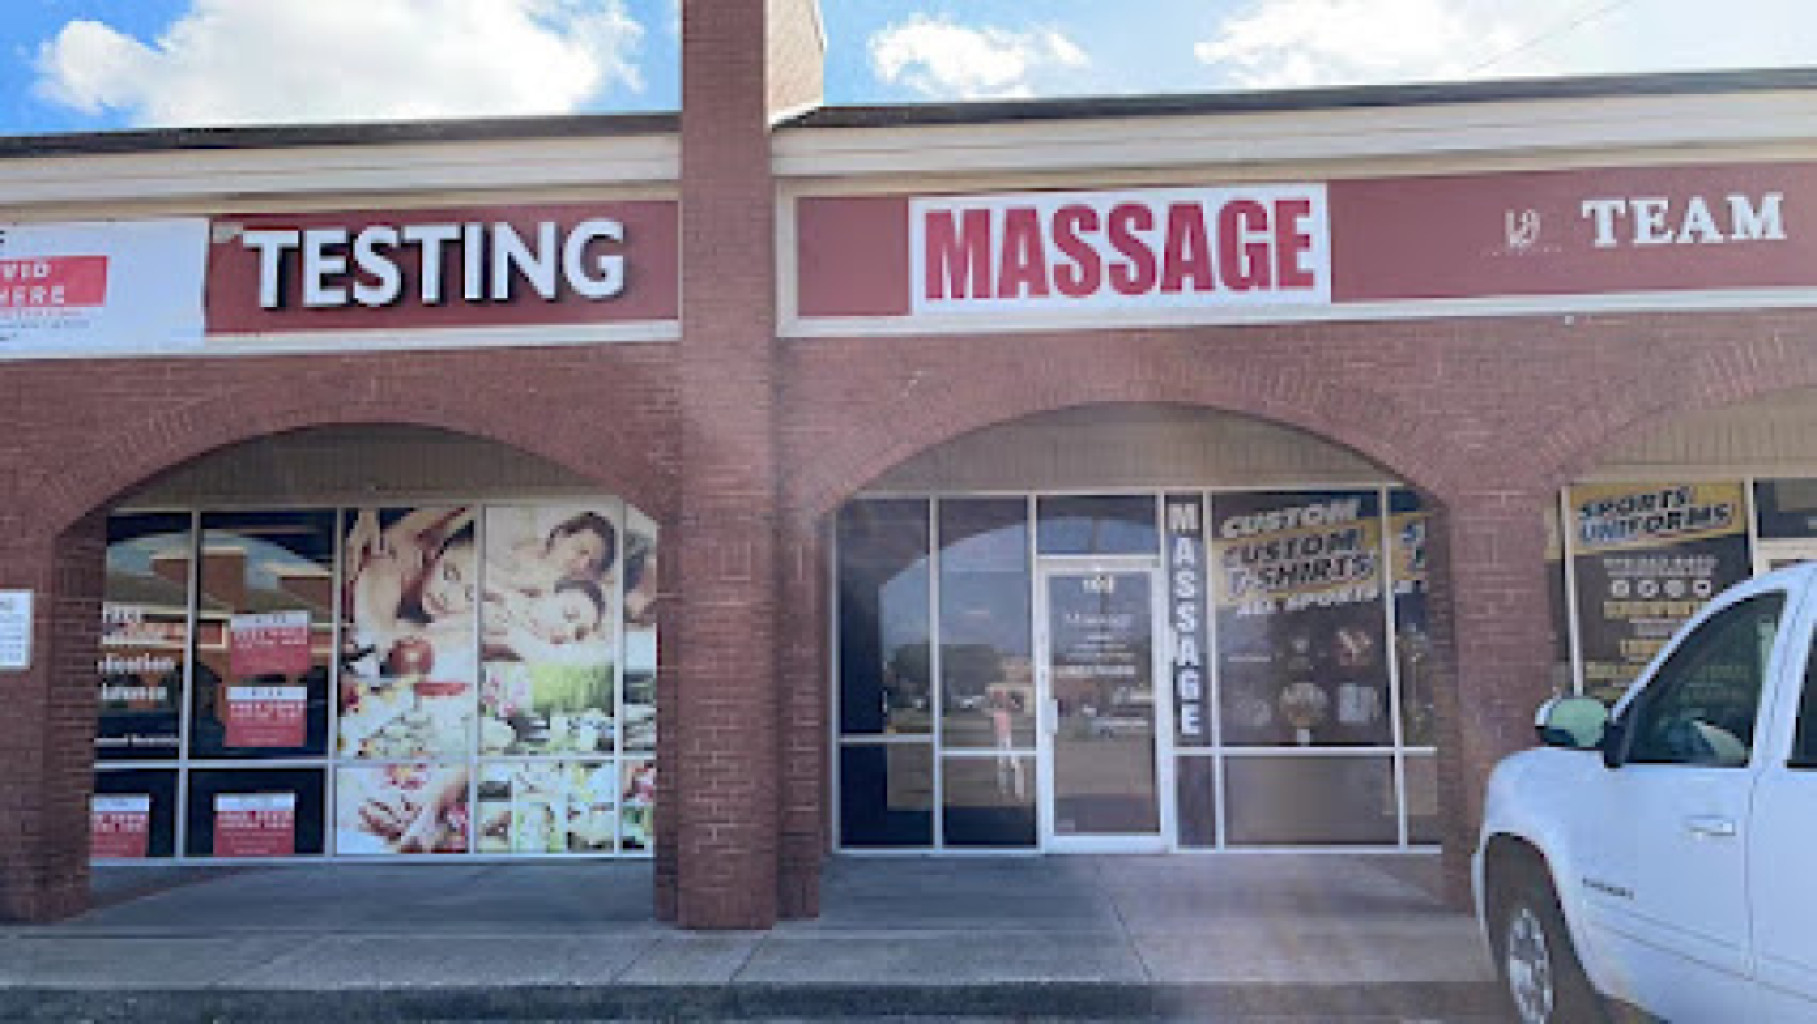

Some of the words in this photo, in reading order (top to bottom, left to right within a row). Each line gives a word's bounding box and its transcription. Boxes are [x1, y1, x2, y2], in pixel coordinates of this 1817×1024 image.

[1581, 192, 1788, 248] TEAM
[241, 218, 626, 308] TESTING
[924, 197, 1317, 302] MASSAGE
[1221, 497, 1361, 538] CUSTOM
[1578, 486, 1694, 519] SPORTS
[1579, 502, 1733, 545] UNIFORMS
[1221, 530, 1363, 569] CUSTOM
[1168, 503, 1203, 736] MASSAGE
